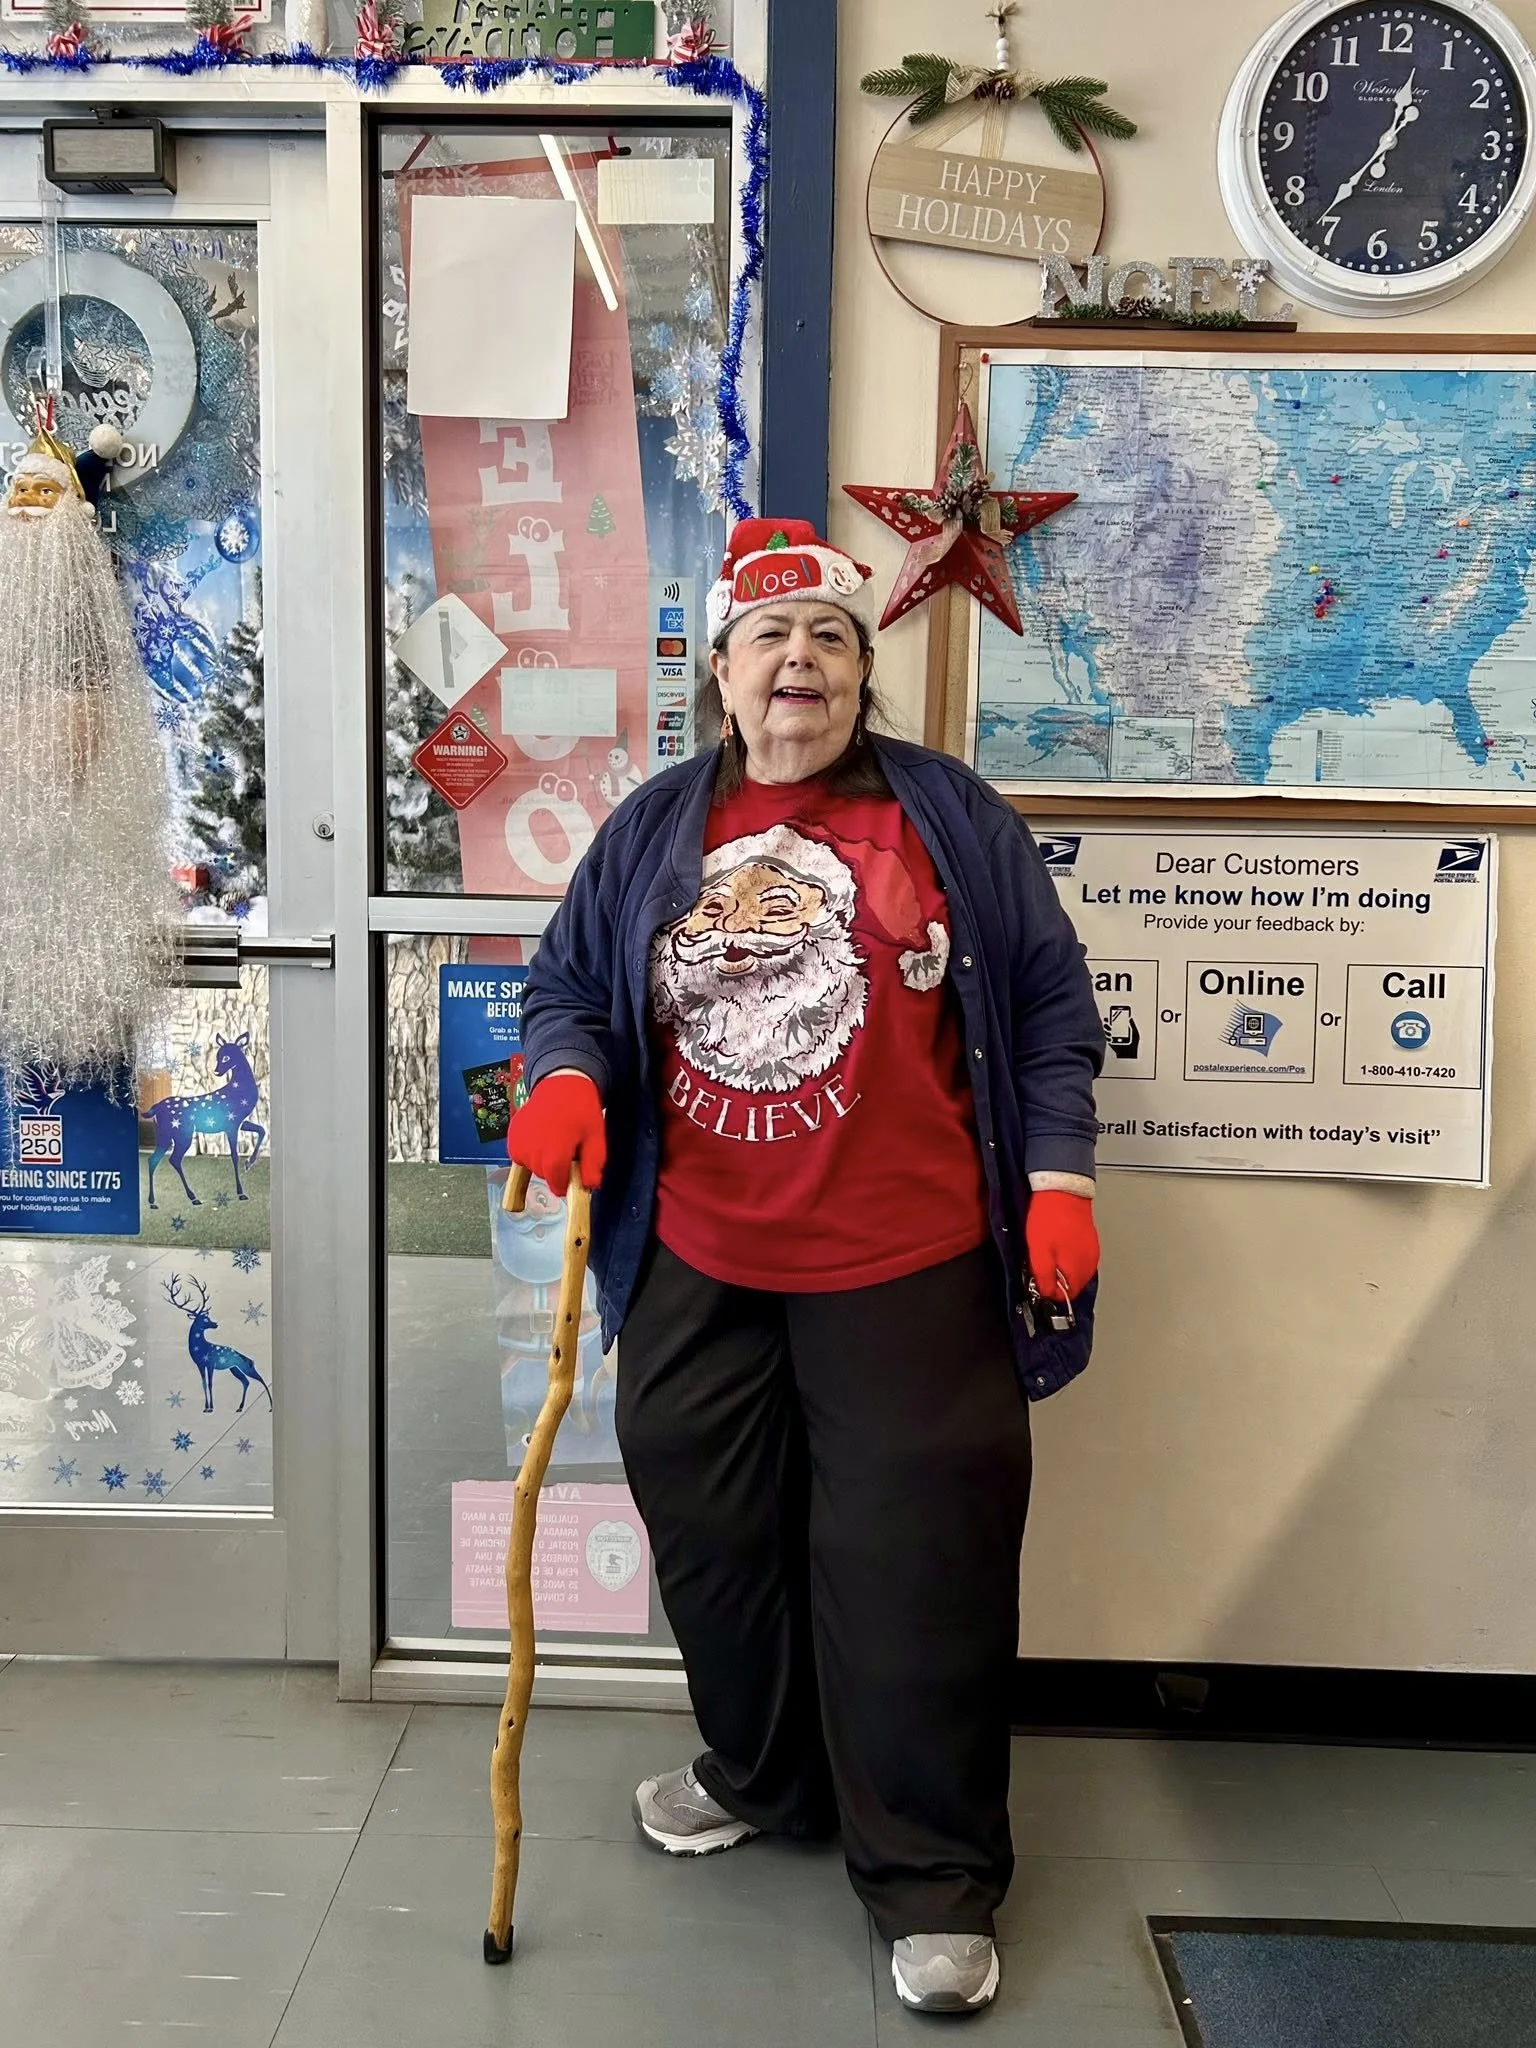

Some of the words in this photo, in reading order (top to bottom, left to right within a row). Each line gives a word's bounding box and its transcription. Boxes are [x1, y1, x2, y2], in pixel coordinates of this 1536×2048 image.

[1378, 22, 1414, 54] 12
[1329, 36, 1360, 67] 11
[1439, 41, 1455, 71] 1
[1291, 71, 1329, 103] 10
[1469, 78, 1490, 109] 2
[1273, 121, 1295, 152] 9
[1481, 130, 1501, 161] 3
[940, 160, 1046, 205] HAPPY
[1284, 175, 1306, 206] 8
[1363, 180, 1403, 194] London
[1458, 183, 1479, 214] 4
[896, 194, 1072, 254] HOLIDAYS
[1322, 216, 1341, 246] 7
[1418, 220, 1439, 251] 5
[1367, 229, 1388, 259] 6
[1037, 253, 1293, 321] NOEL
[740, 556, 814, 599] Noel
[668, 620, 684, 628] EX
[661, 667, 683, 676] VISA
[433, 744, 488, 757] WARNING!
[658, 740, 685, 753] JCB
[1155, 852, 1216, 876] Dear
[1224, 853, 1360, 876] Customers
[1082, 884, 1122, 905] Let
[1128, 888, 1167, 905] me
[1174, 885, 1243, 907] know
[1251, 886, 1304, 908] how
[1312, 887, 1350, 909] I'm
[1358, 888, 1431, 914] doing
[1144, 914, 1208, 931] Provide
[1212, 919, 1253, 935] your
[1256, 915, 1335, 933] feedback
[1339, 917, 1366, 937] by:
[448, 980, 496, 998] MAKE
[1093, 972, 1132, 992] an
[1200, 969, 1305, 996] Online
[1382, 972, 1446, 999] Call
[487, 1002, 523, 1018] BEFOR
[1160, 1009, 1182, 1023] Or
[1320, 1012, 1341, 1028] Or
[1193, 1064, 1306, 1074] postalexperience.com/Pos
[1360, 1065, 1456, 1079] 1-800-410-7420
[667, 1066, 862, 1142] BELIEVE
[20, 1123, 61, 1137] USPS
[1097, 1120, 1136, 1135] erall
[1143, 1120, 1257, 1139] Satisfaction
[1263, 1123, 1303, 1140] with
[1309, 1125, 1381, 1145] today's
[1387, 1128, 1441, 1146] visit"
[21, 1138, 61, 1155] 250
[0, 1169, 43, 1188] ERING
[46, 1170, 87, 1189] SINCE
[91, 1171, 121, 1190] 1775
[2, 1204, 19, 1212] your
[20, 1204, 52, 1212] holidays
[24, 1195, 57, 1203] counting
